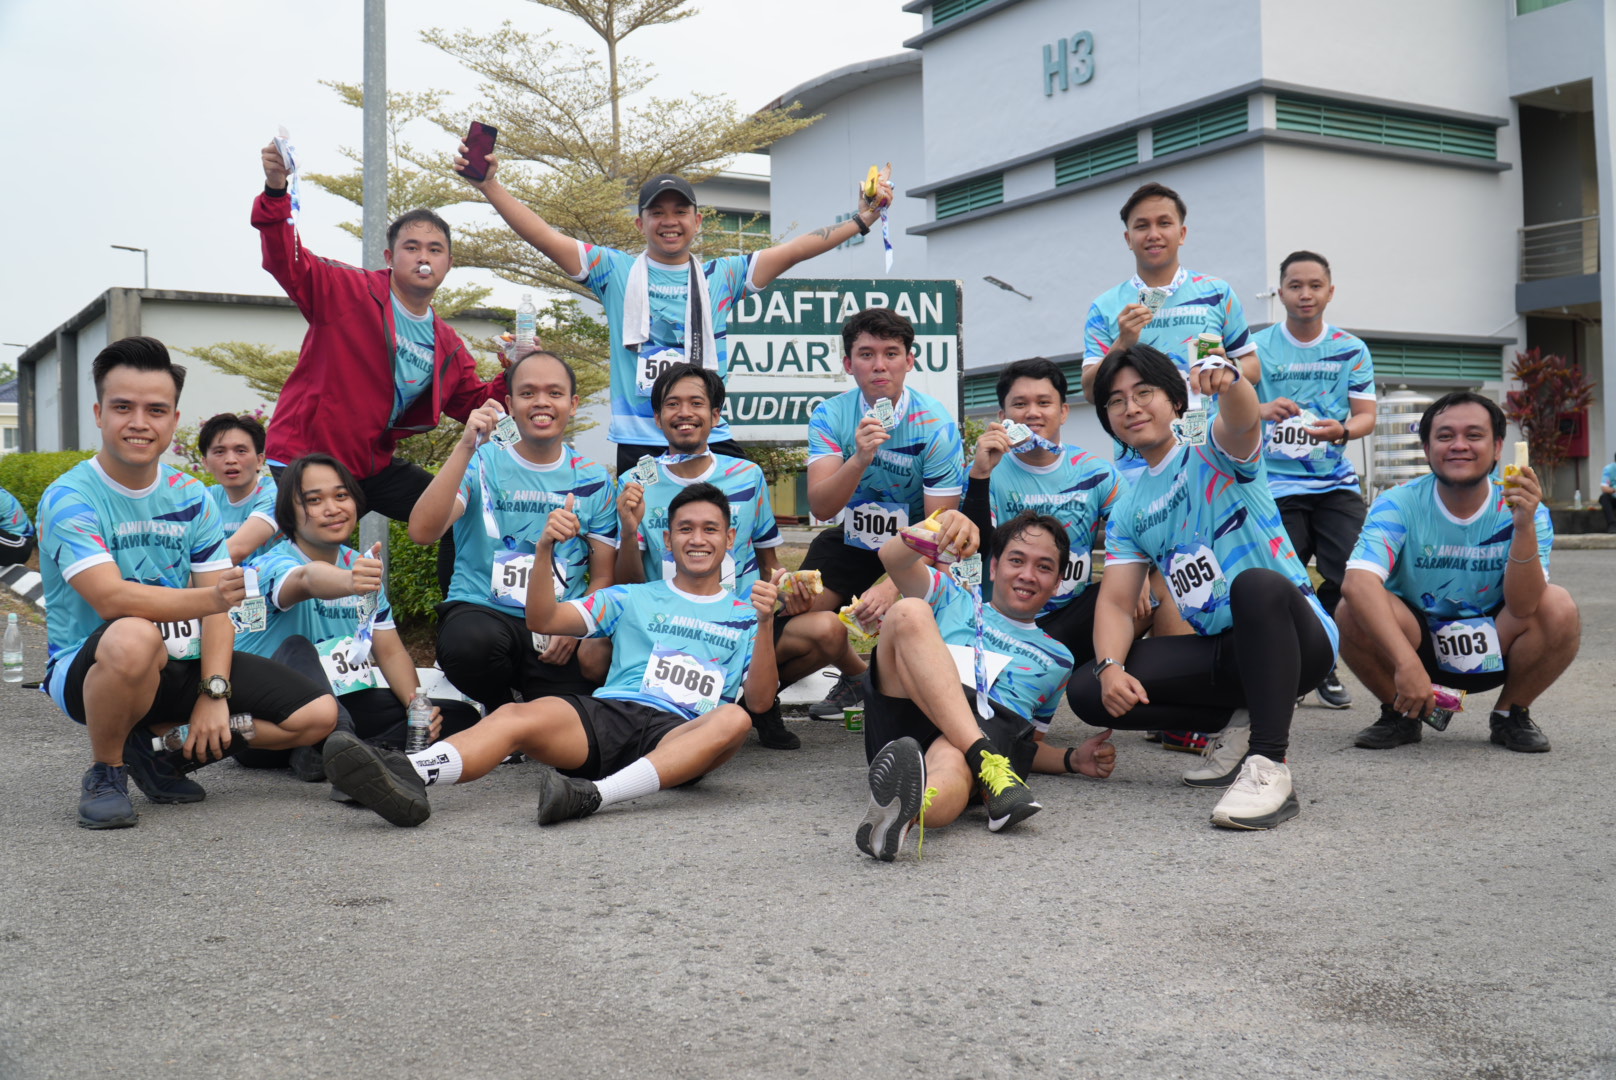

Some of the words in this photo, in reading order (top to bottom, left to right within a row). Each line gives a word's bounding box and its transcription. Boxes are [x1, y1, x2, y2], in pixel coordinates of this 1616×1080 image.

[1043, 30, 1095, 97] H3
[1172, 316, 1207, 327] SKILLS
[882, 461, 912, 477] SKILLS
[495, 500, 546, 513] SARAWAK
[853, 511, 898, 536] 5104
[1415, 557, 1468, 571] SARAWAK
[1170, 556, 1215, 598] 5095
[647, 623, 702, 640] SARAWAK
[703, 633, 737, 651] SKILLS
[671, 616, 742, 640] ANNIVERSARY
[1437, 632, 1488, 656] 5103
[1013, 646, 1049, 671] SKILLS
[654, 658, 715, 697] 5086
